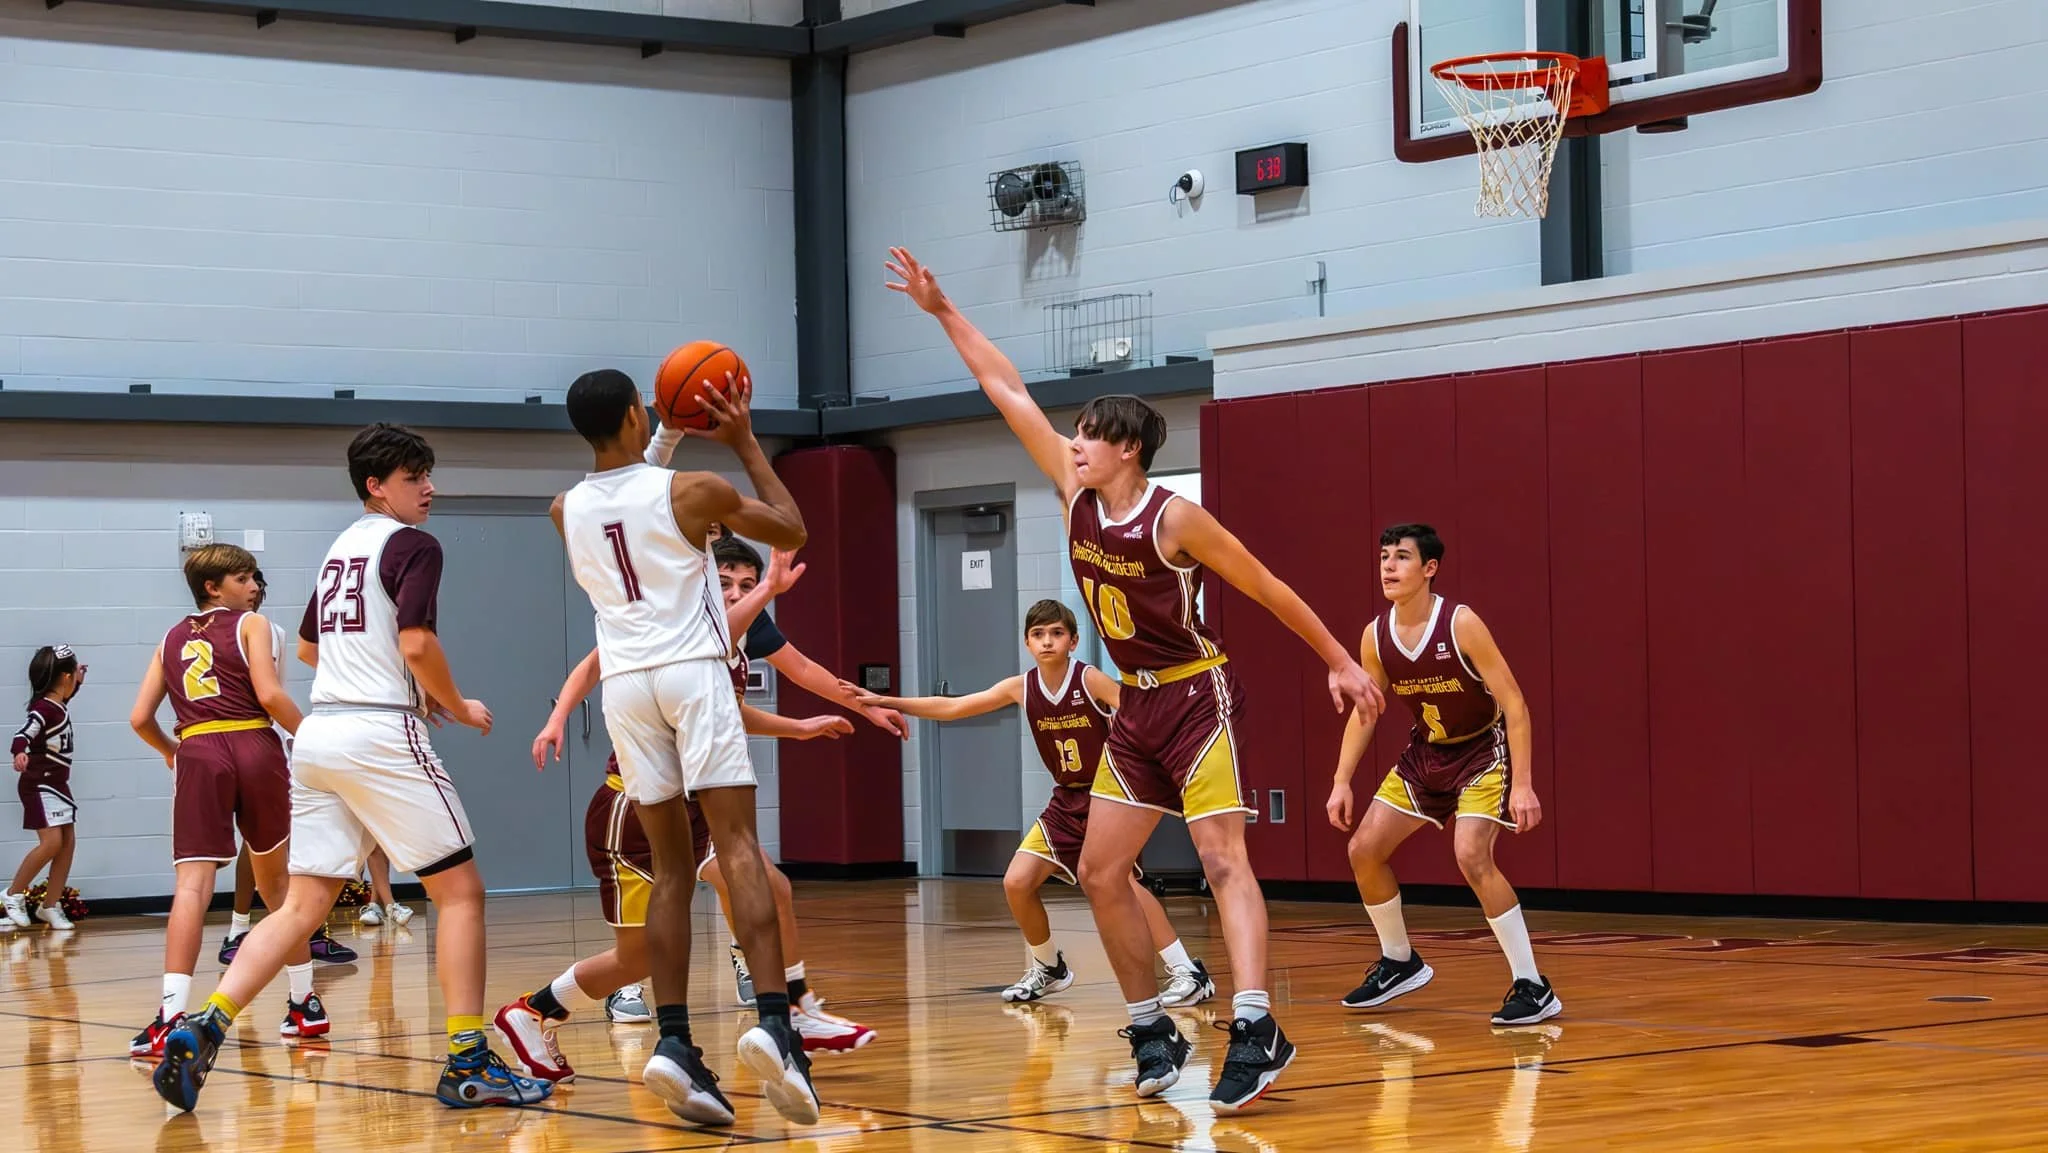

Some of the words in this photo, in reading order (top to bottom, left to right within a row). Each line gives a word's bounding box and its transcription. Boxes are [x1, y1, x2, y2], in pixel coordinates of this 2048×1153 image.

[601, 519, 644, 602] 1
[970, 559, 984, 569] EXIT
[320, 556, 369, 634] 23
[1082, 576, 1136, 640] 10
[181, 639, 221, 702] 2
[1423, 677, 1464, 694] ACADEMY
